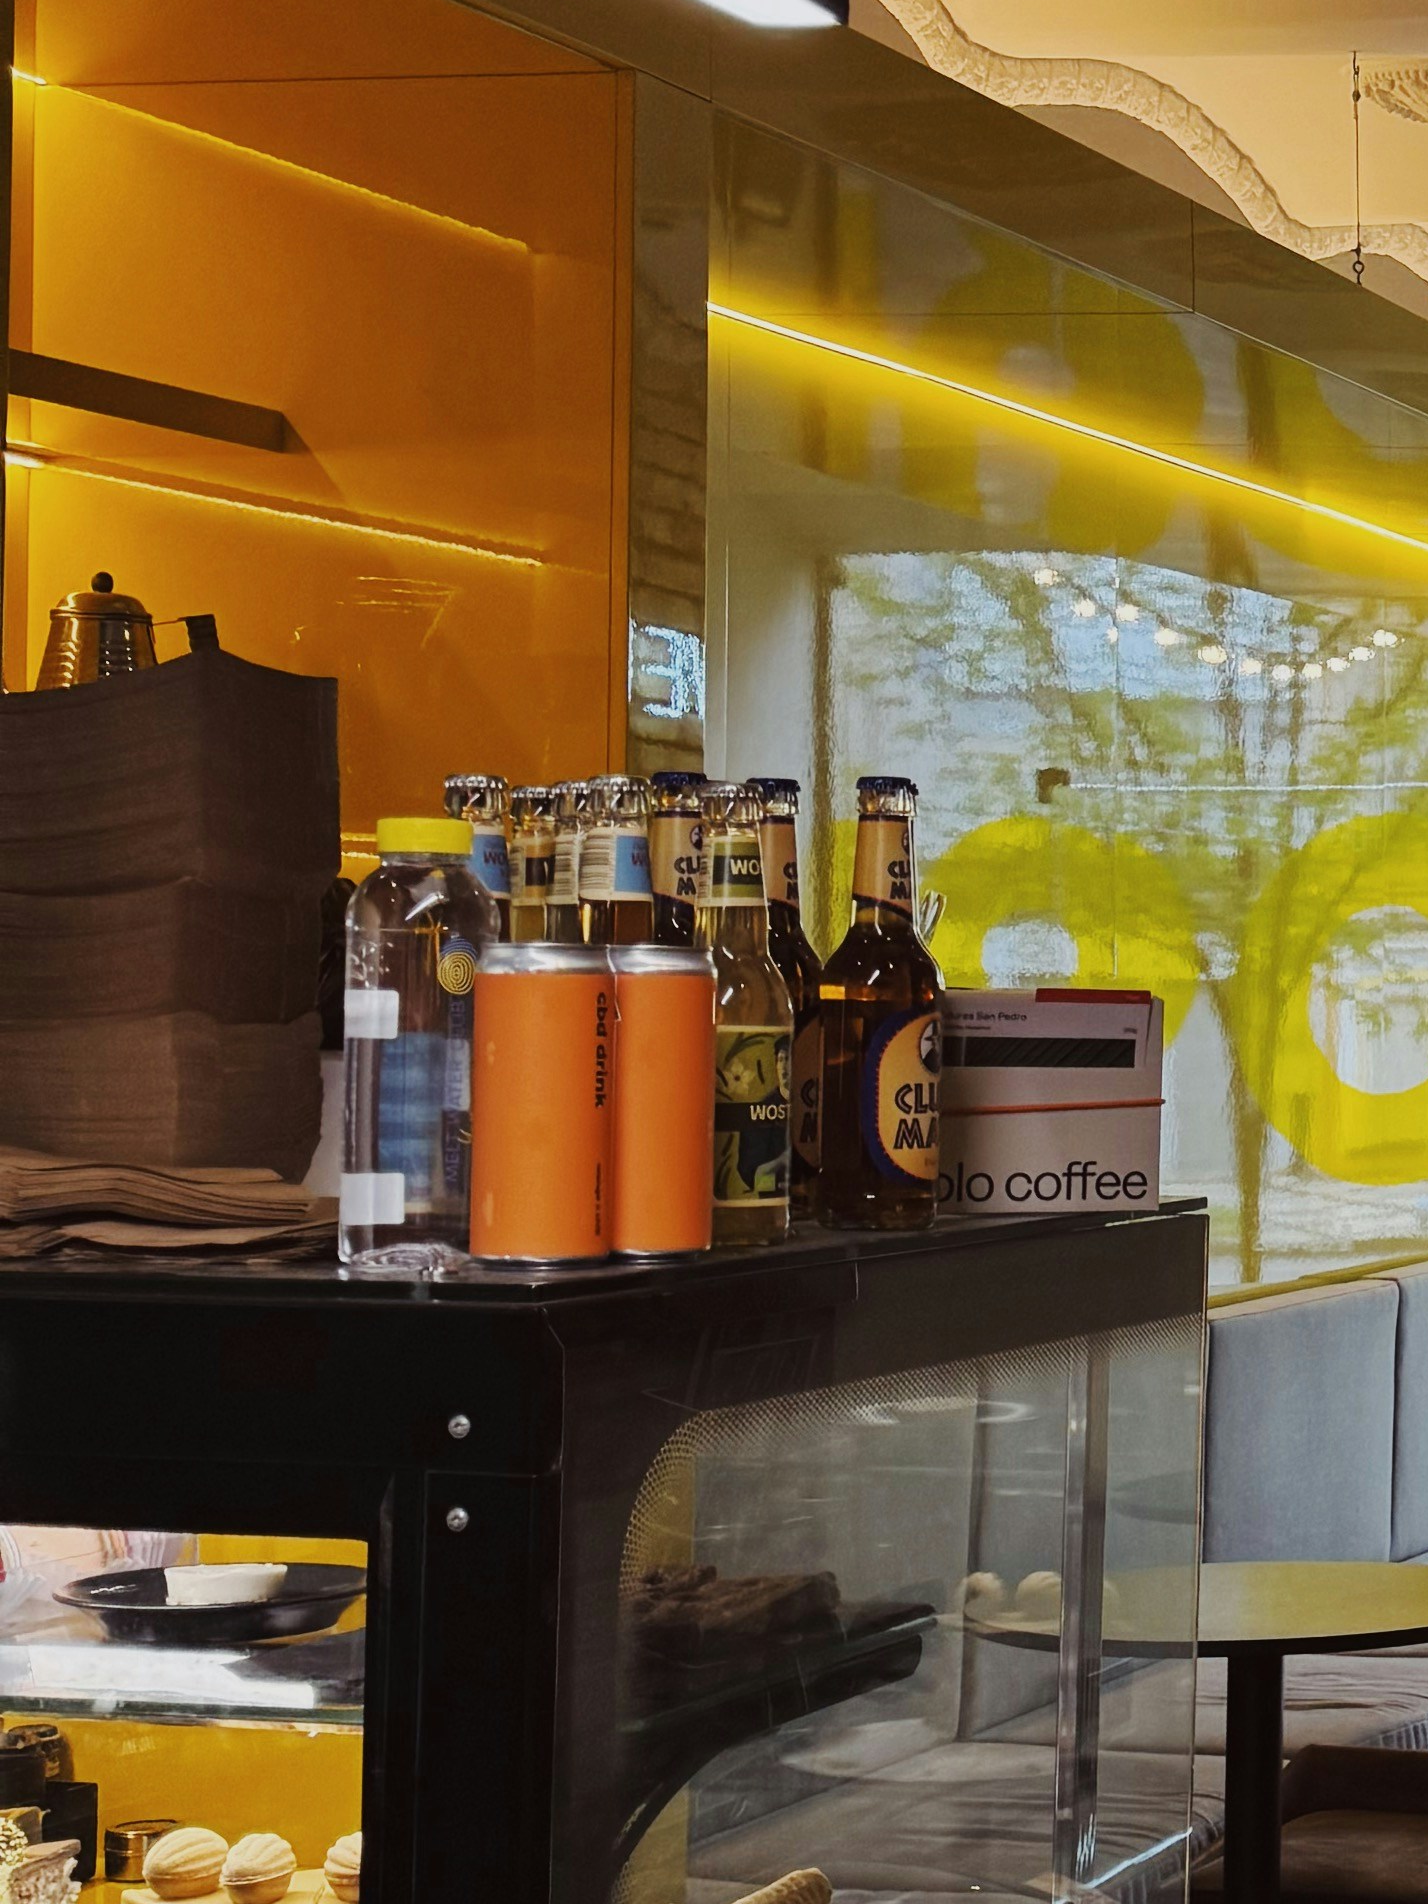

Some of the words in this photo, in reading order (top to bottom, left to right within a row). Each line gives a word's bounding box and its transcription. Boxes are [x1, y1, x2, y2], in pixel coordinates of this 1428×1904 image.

[597, 992, 607, 1037] cbd
[596, 1044, 607, 1107] drink
[1005, 1159, 1148, 1202] coffee
